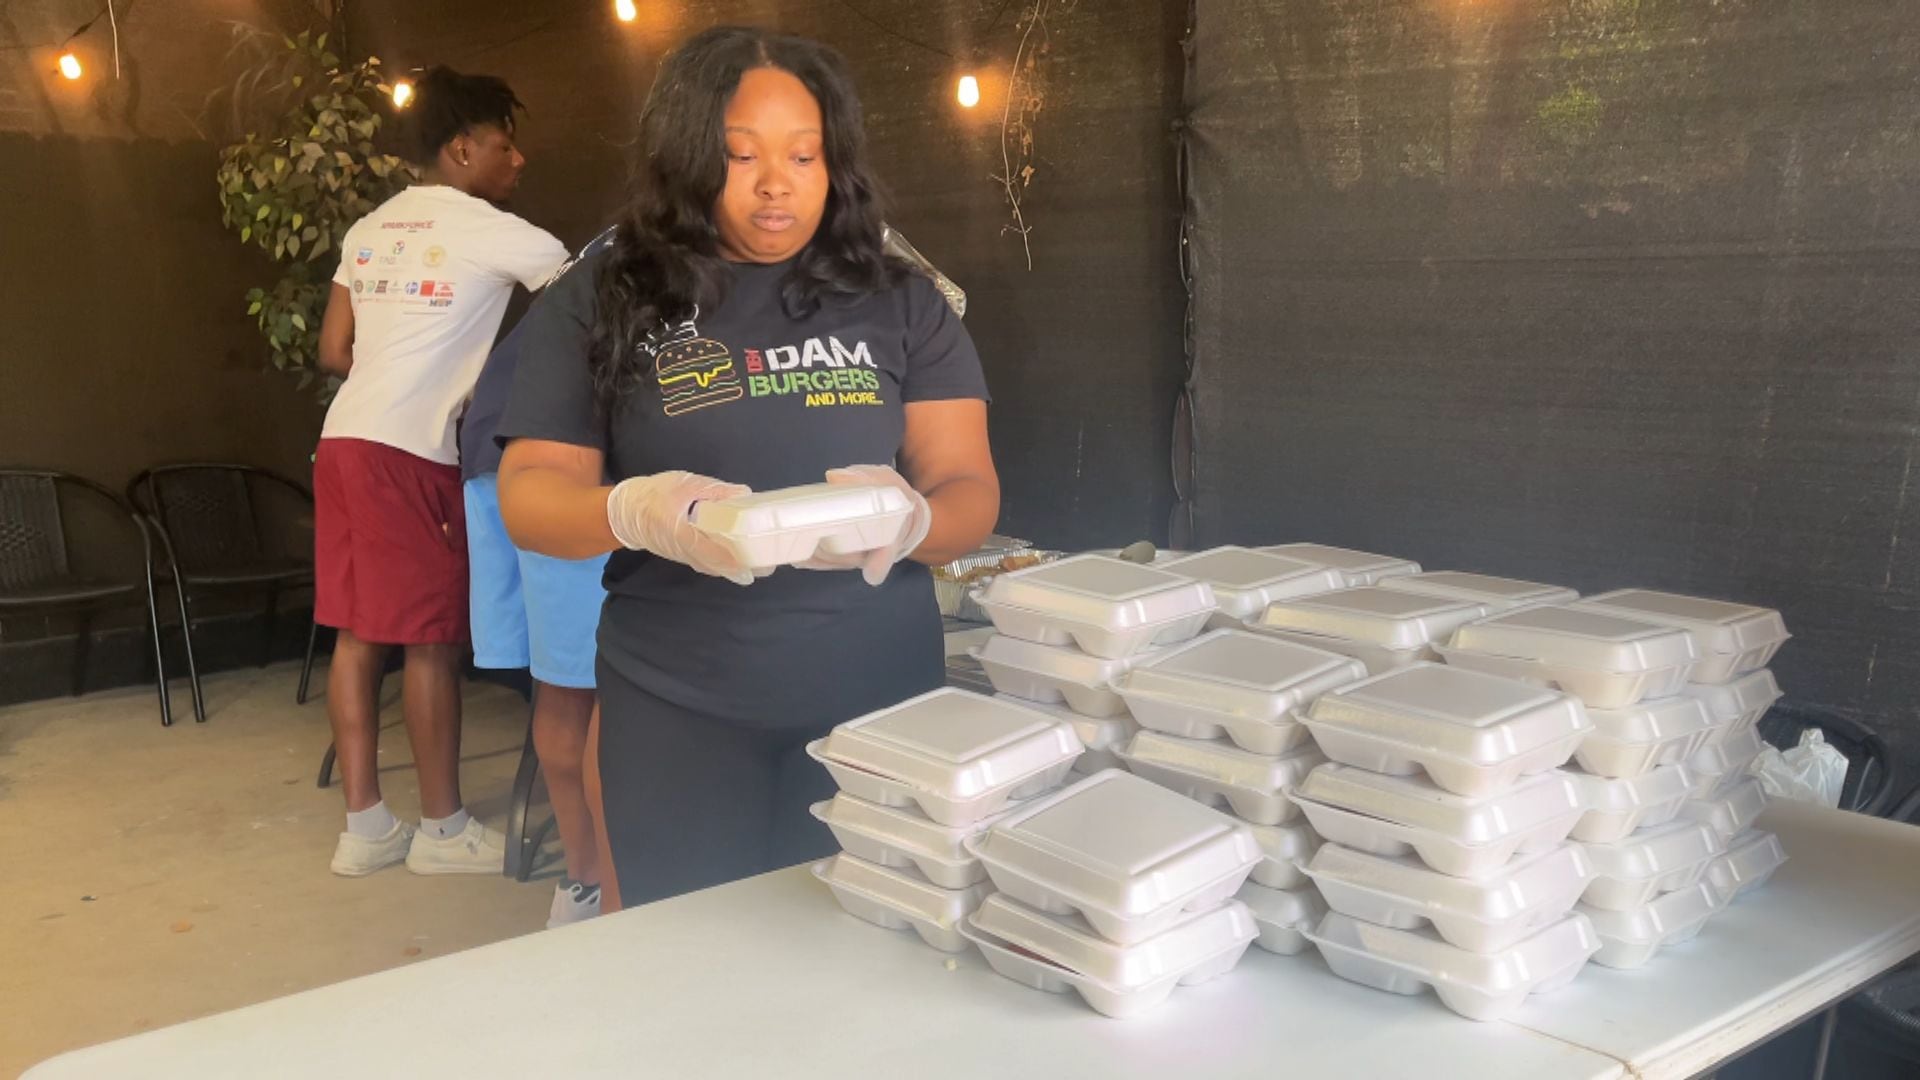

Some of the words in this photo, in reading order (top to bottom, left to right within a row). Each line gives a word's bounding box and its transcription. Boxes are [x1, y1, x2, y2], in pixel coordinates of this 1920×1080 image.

[765, 336, 878, 370] DAM
[748, 368, 880, 397] BURGERS
[805, 393, 836, 407] AND
